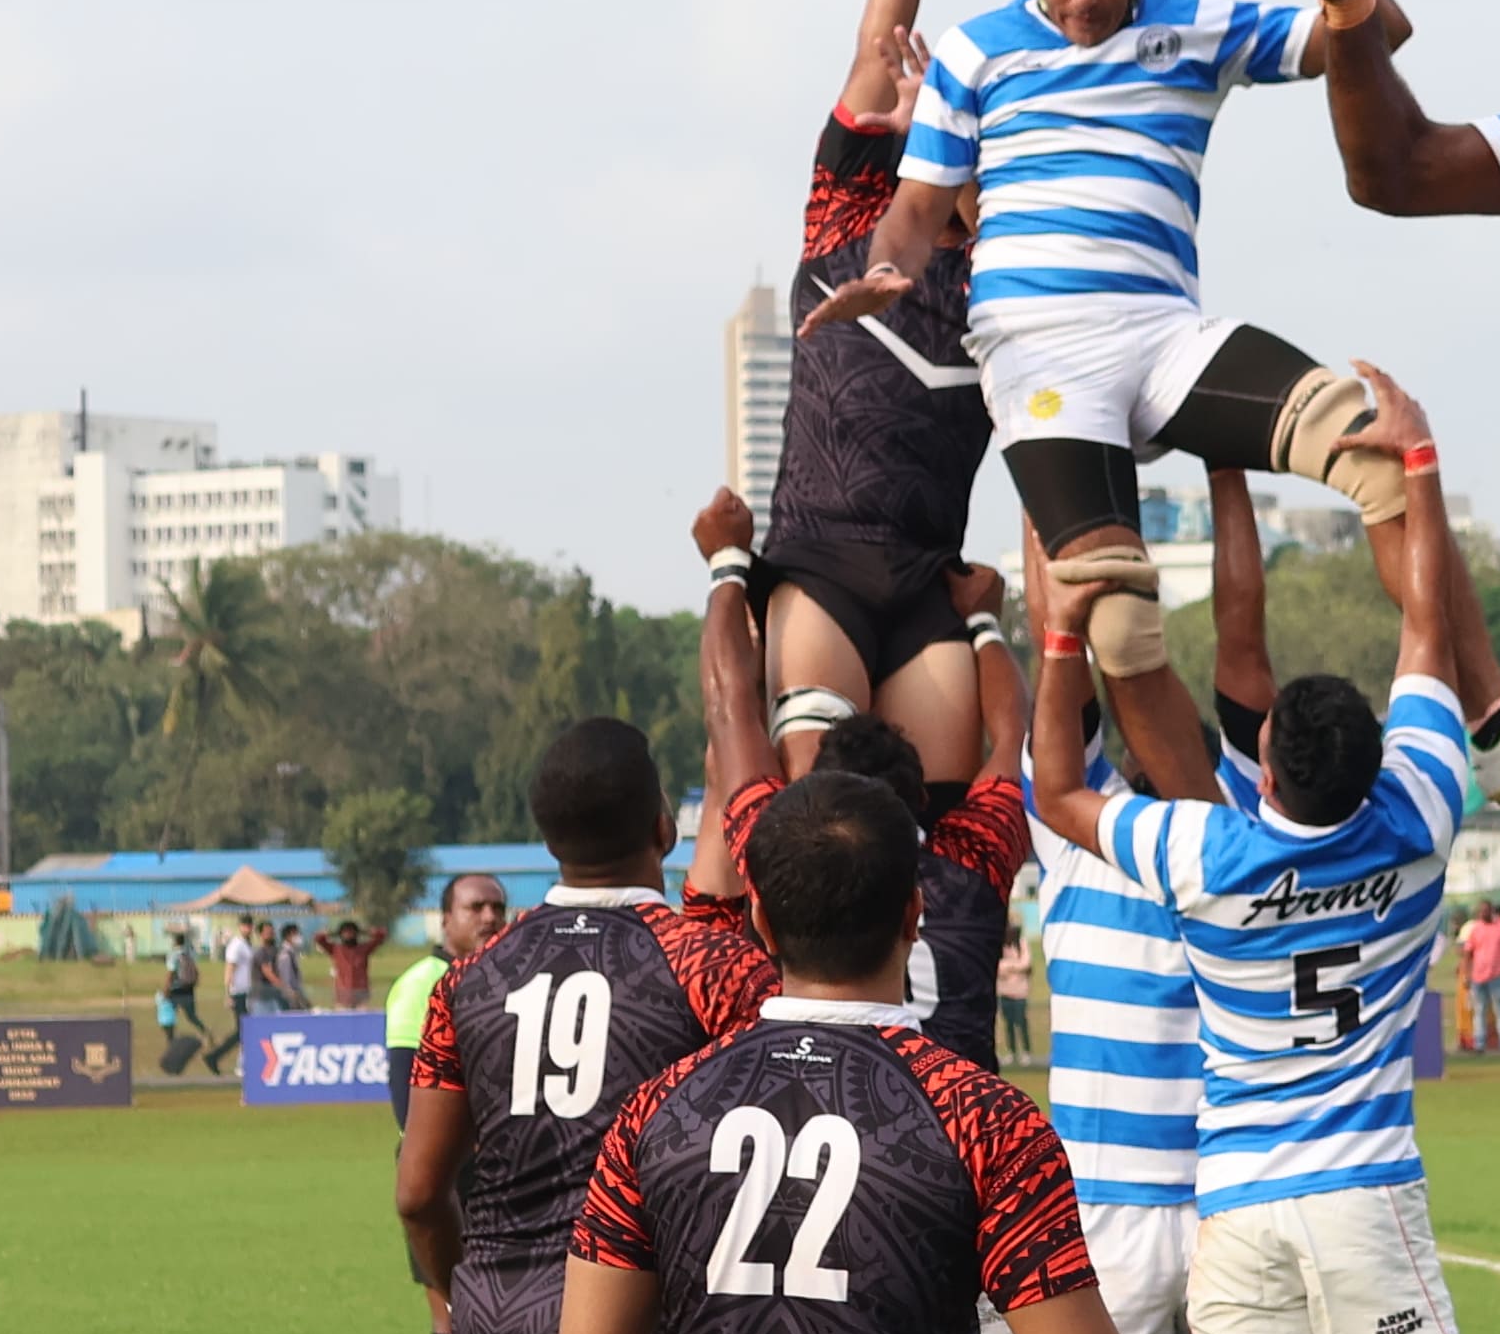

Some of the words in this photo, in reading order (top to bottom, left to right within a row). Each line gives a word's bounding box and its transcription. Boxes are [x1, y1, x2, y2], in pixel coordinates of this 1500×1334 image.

[1240, 869, 1403, 924] Army
[504, 970, 612, 1120] 19
[1292, 943, 1362, 1049] 5
[706, 1105, 861, 1302] 22
[1378, 1307, 1416, 1328] ARMY
